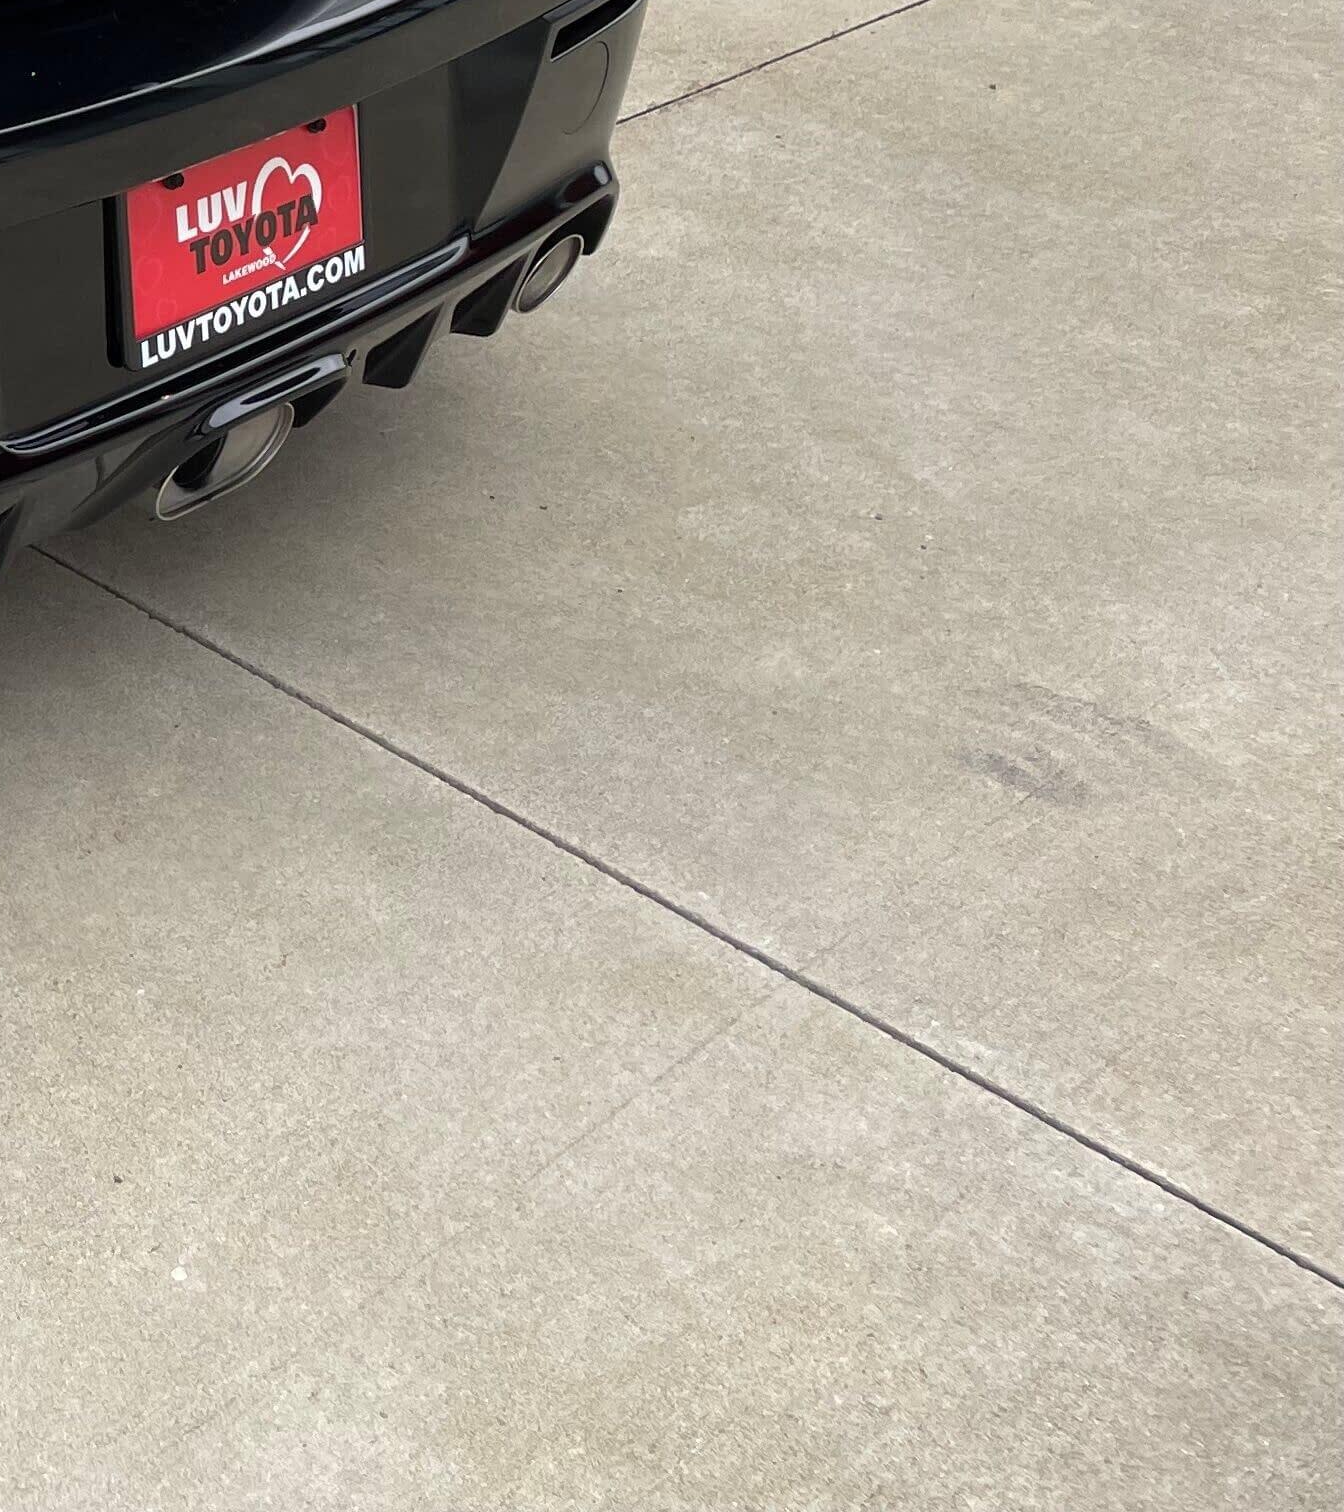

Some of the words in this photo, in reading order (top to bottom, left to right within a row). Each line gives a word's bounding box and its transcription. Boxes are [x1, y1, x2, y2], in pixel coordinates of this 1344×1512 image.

[175, 181, 248, 243] LUV
[189, 194, 319, 275] TOYOTA
[222, 252, 277, 286] LAKEWOOD
[140, 244, 367, 369] LUVTOYOTA.COM
